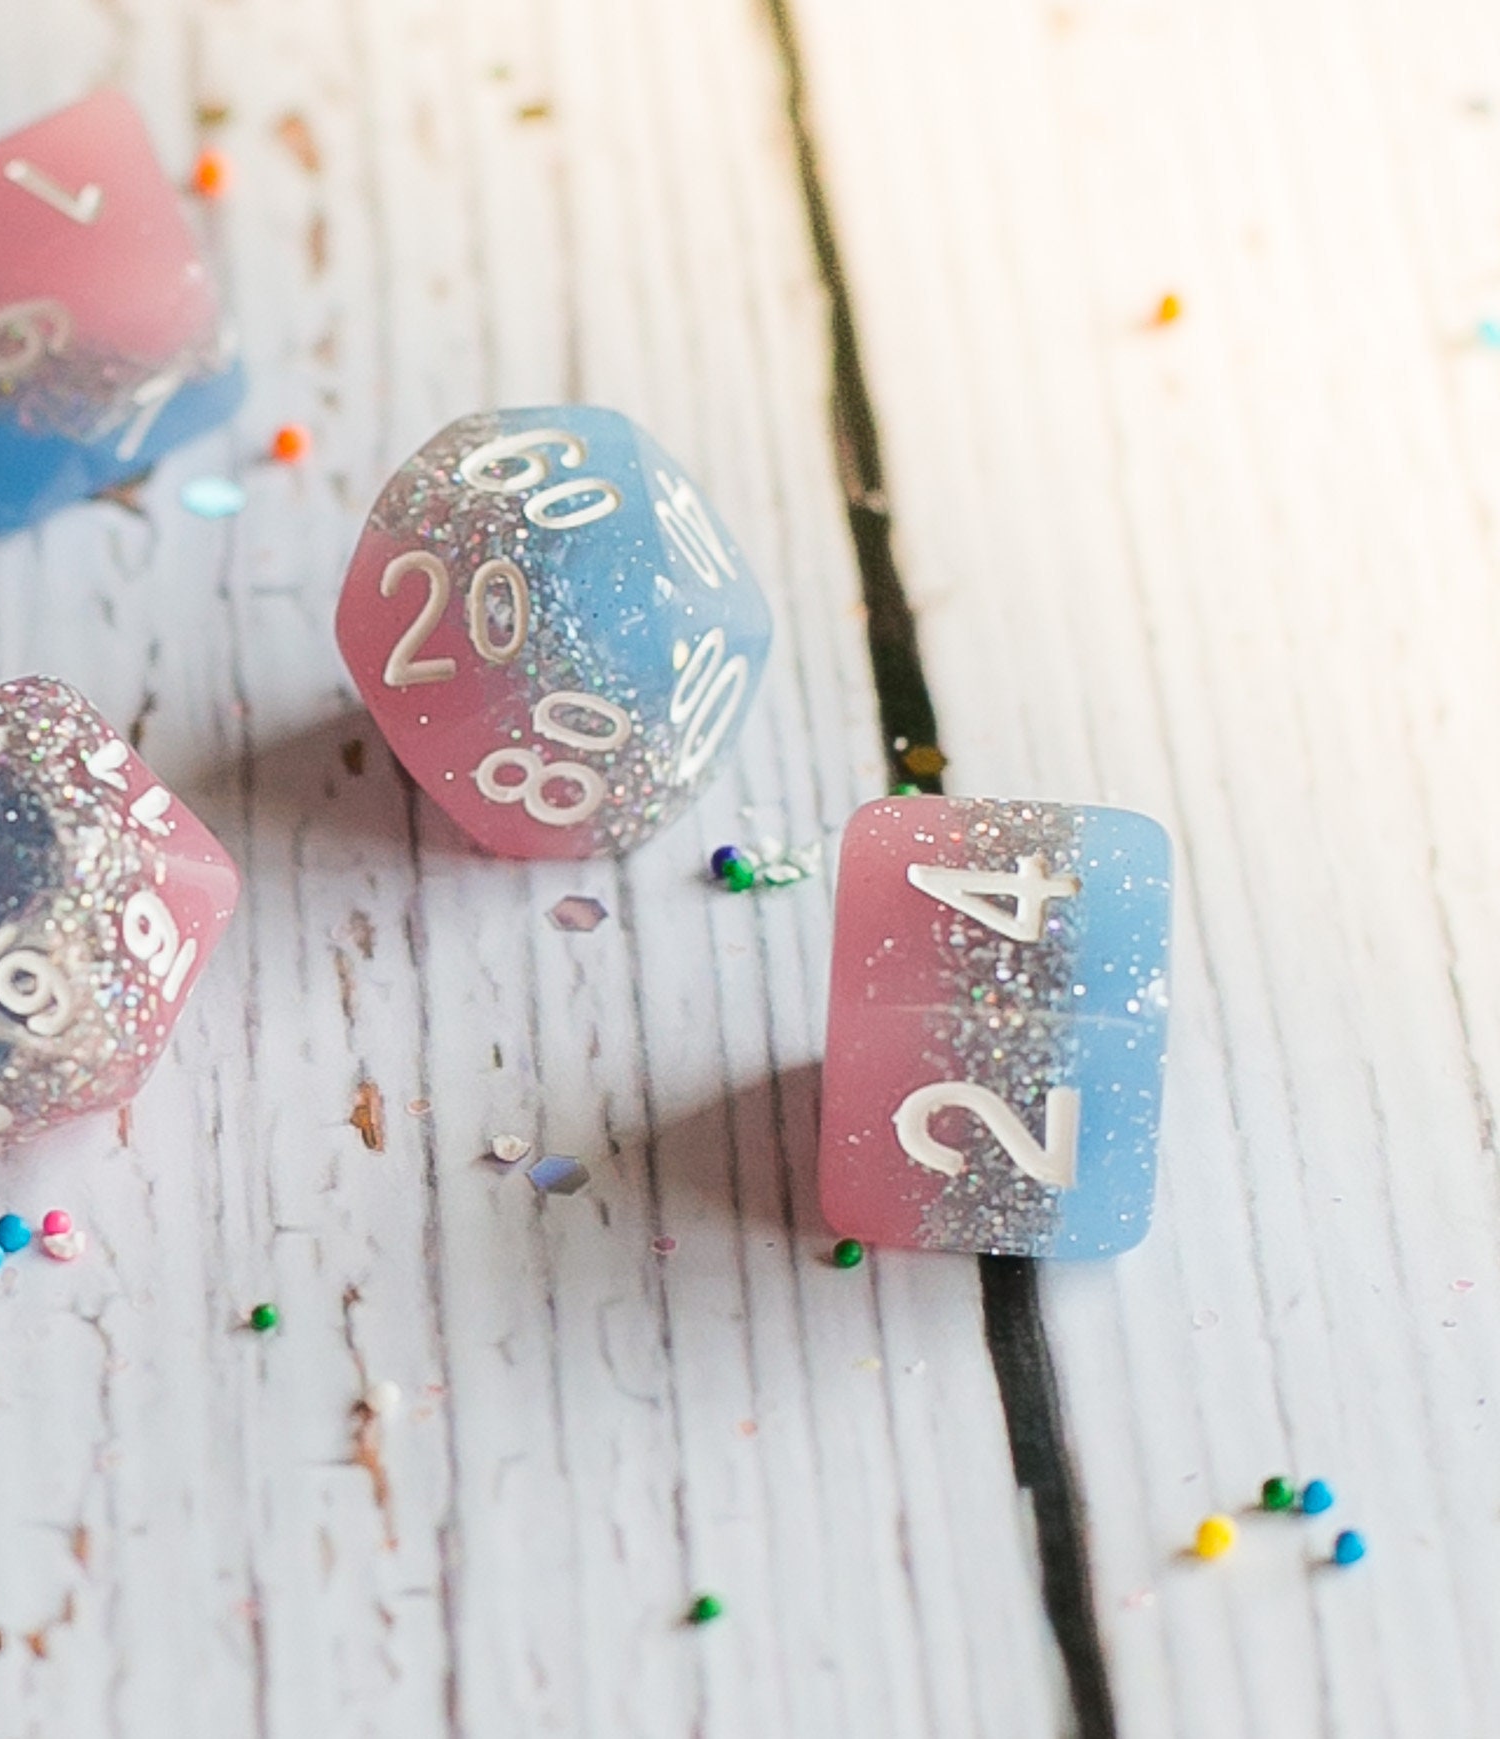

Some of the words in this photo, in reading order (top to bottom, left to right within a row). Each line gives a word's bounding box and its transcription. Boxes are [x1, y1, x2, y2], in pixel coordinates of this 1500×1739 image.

[460, 427, 621, 530] 60
[380, 550, 531, 687] 20
[473, 689, 632, 826] 80
[905, 852, 1084, 944] 4
[890, 1080, 1082, 1190] 2
